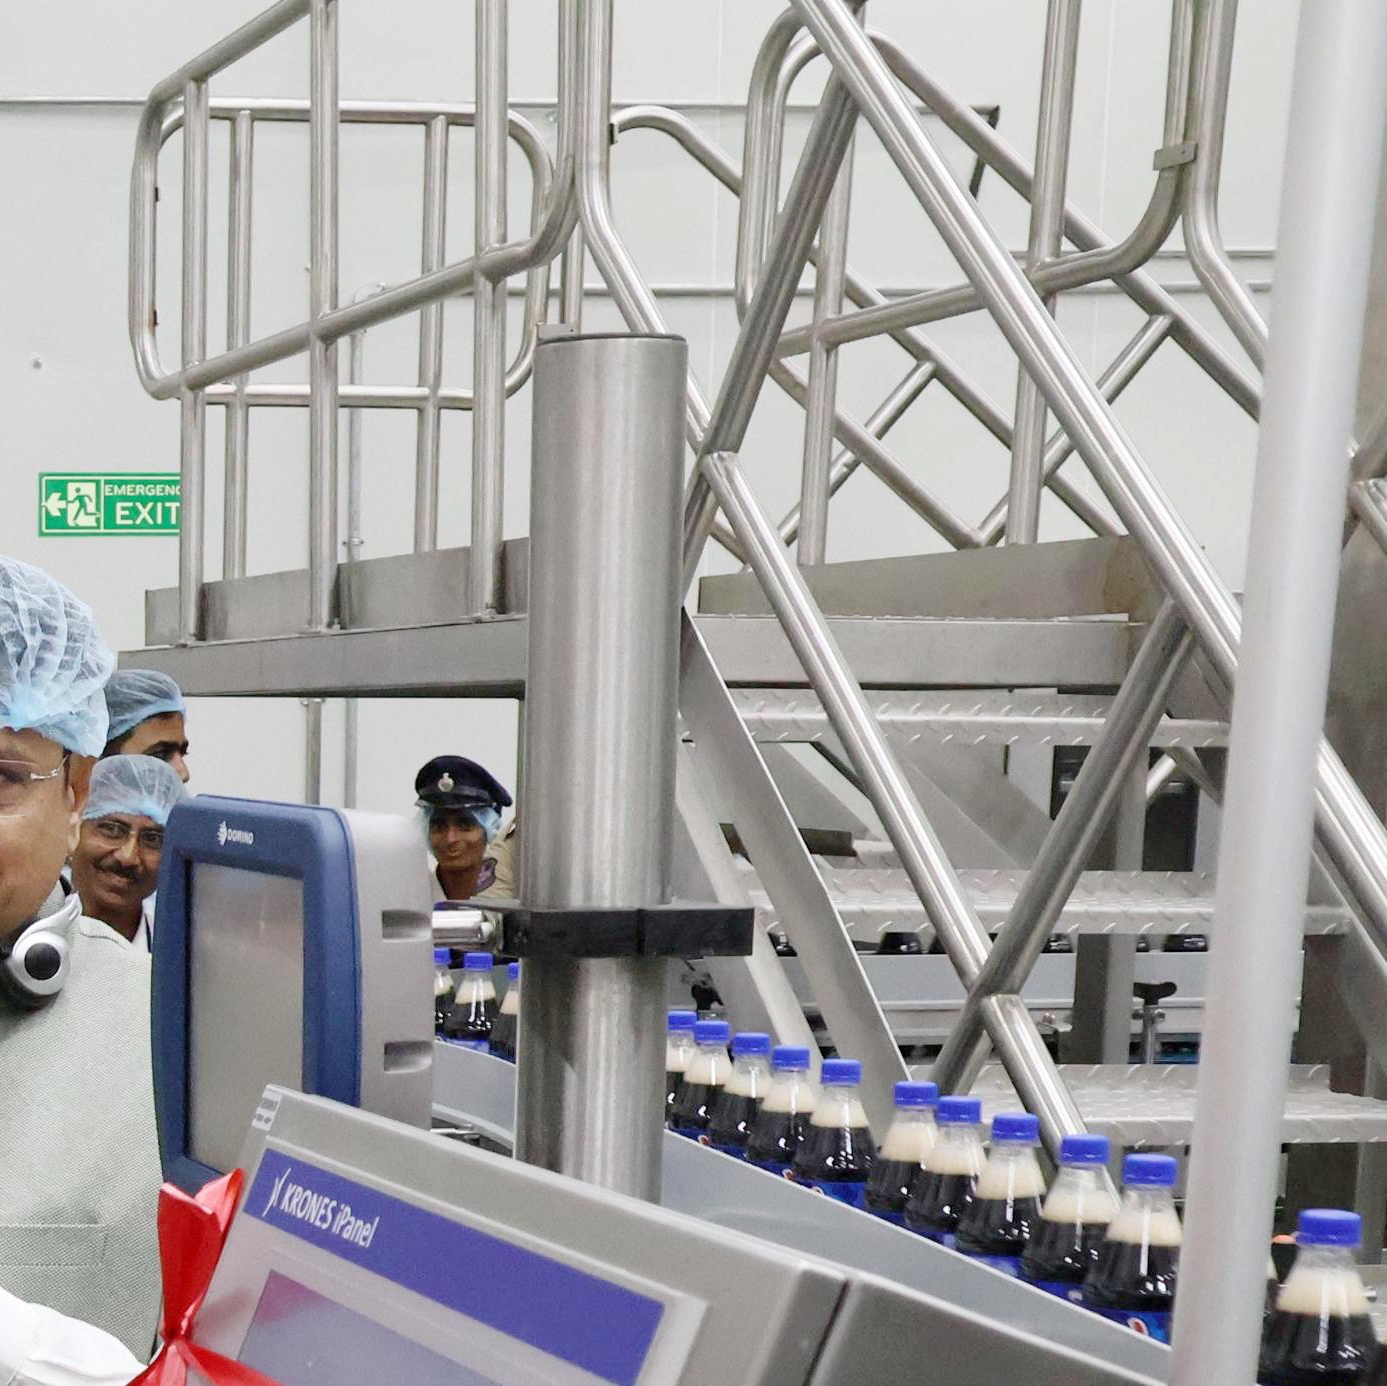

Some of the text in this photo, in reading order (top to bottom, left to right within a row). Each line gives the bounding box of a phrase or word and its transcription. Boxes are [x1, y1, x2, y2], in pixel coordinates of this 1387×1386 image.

[115, 502, 180, 525] EXIT
[227, 828, 254, 845] DOMINO
[280, 1183, 379, 1249] KRONES iPanel
